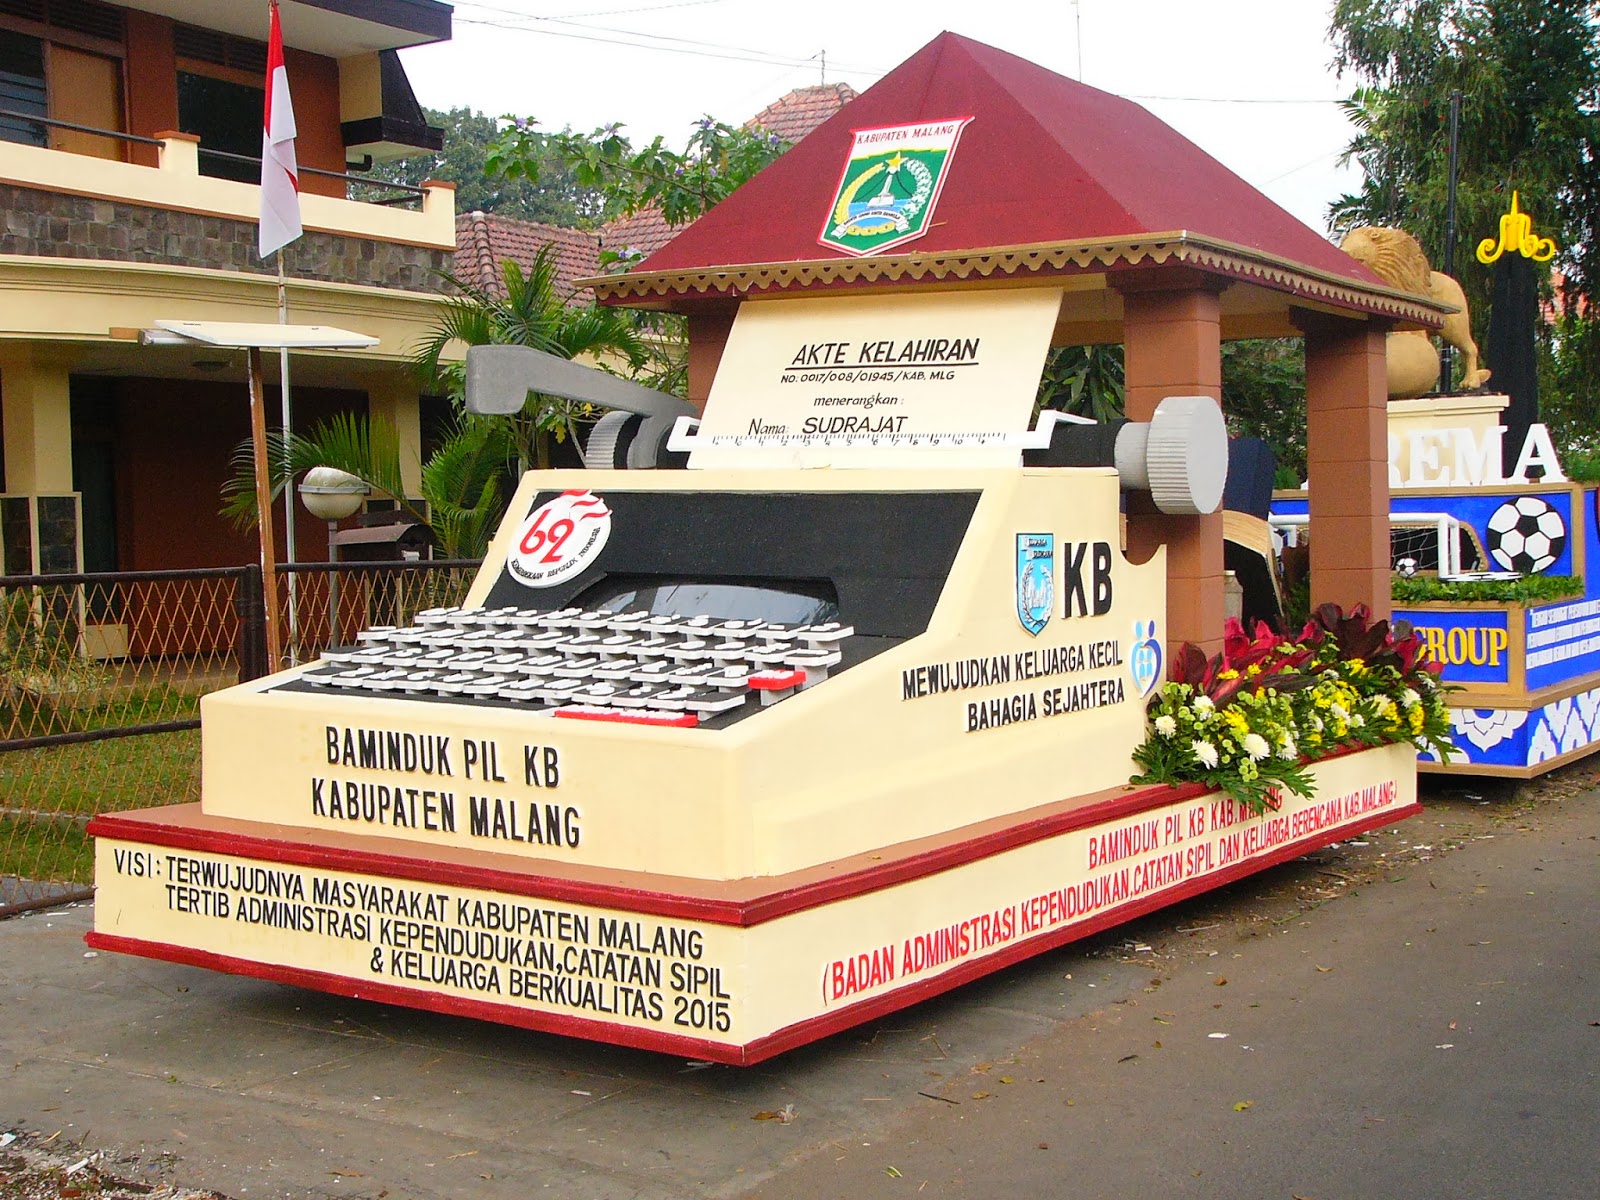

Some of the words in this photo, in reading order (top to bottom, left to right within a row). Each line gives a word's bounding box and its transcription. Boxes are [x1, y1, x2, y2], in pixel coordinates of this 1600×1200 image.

[857, 130, 909, 145] KABUPATEN
[912, 124, 955, 139] MALANG
[792, 342, 849, 365] AKTE
[859, 338, 980, 363] KELAHIRAN
[929, 370, 956, 381] MLG
[801, 416, 908, 435] SUDRAJAT
[1063, 541, 1113, 619] KB
[902, 655, 1010, 701] MEWUJUDKAN
[1014, 644, 1085, 682] KELUARGA
[1088, 640, 1123, 671] KECIL
[967, 692, 1037, 732] BAHAGIA
[1043, 677, 1125, 717] SEJAHTERA
[326, 725, 453, 776] BAMINDUK
[463, 739, 506, 782] PIL
[524, 745, 560, 788] KB
[311, 777, 457, 832] KABUPATEN
[469, 796, 581, 848] MALANG
[1088, 819, 1159, 870] BAMINDUK
[1164, 813, 1183, 847] PIL
[1188, 806, 1205, 838] KB
[165, 856, 305, 902] TERWUJUDNYA
[313, 877, 450, 923] MASYARAKAT
[457, 898, 590, 945] KABUPATEN
[599, 918, 704, 960] MALANG
[902, 905, 1016, 977] ADMINISTRASI
[1186, 842, 1214, 878] SIPIL
[1219, 833, 1240, 866] DAN
[1243, 817, 1289, 857] KELUARGA
[1292, 804, 1342, 837] BERENCANA
[165, 884, 230, 919] TERTIB
[236, 896, 371, 943] ADMINISTRASI
[670, 962, 731, 1000] SIPIL
[370, 946, 384, 973] &
[391, 950, 501, 994] KELUARGA
[509, 968, 664, 1022] BERKUALITAS
[673, 995, 732, 1033] 2015
